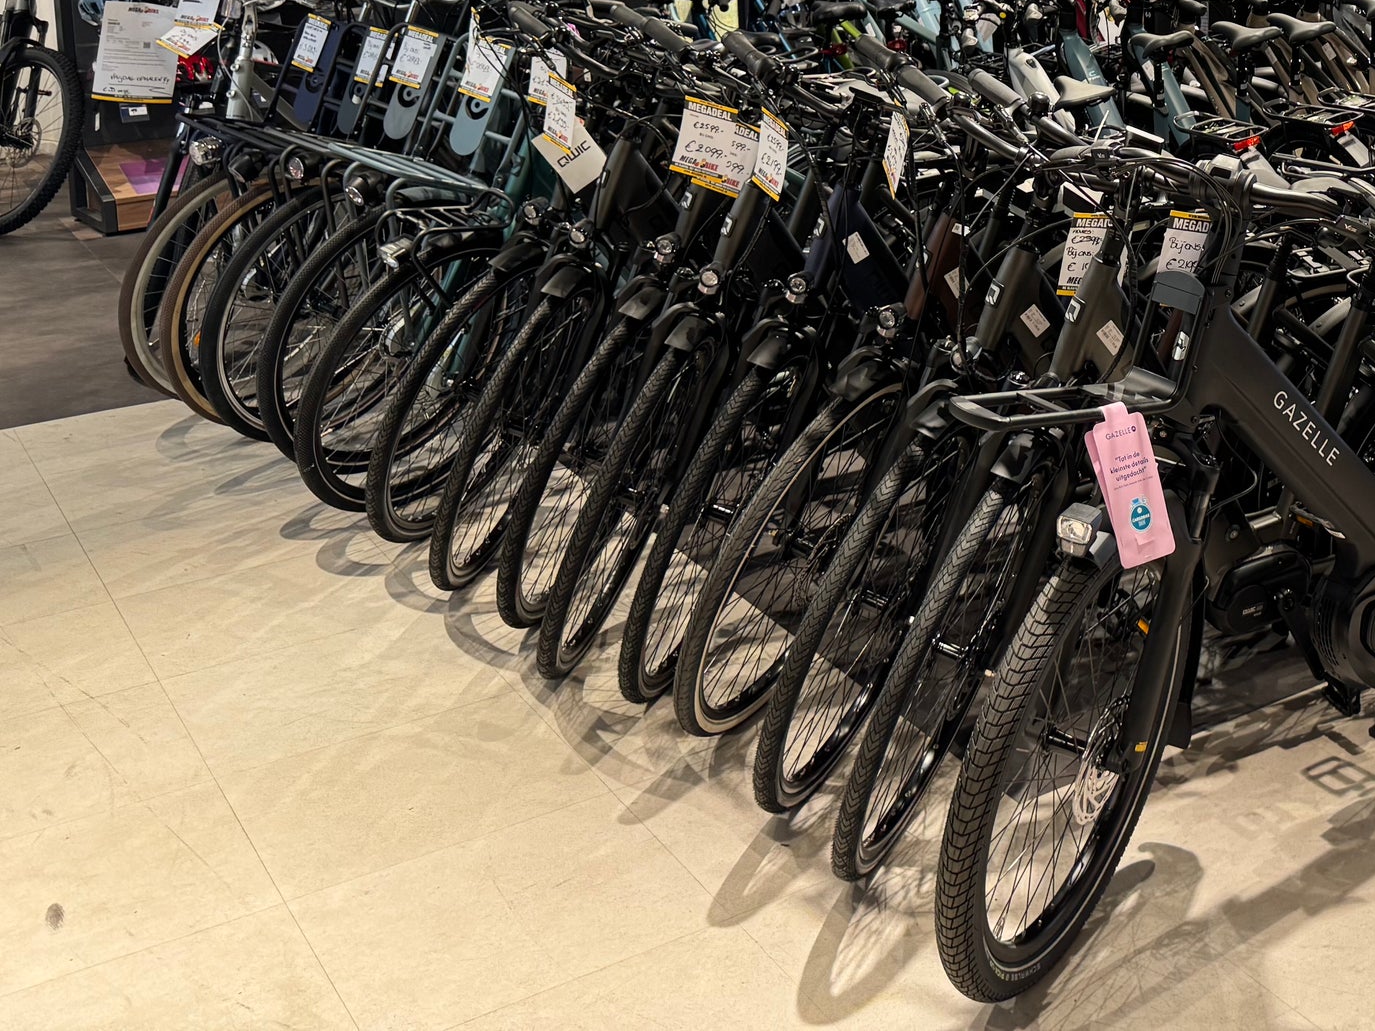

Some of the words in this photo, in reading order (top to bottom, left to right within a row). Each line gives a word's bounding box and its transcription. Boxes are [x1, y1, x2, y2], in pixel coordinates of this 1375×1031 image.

[688, 101, 733, 121] MEGADEAL
[556, 140, 591, 168] QWIC
[1105, 428, 1132, 441] GAZELLE
[1273, 390, 1340, 466] GAZELLE
[1110, 462, 1132, 475] kleinste
[1131, 457, 1149, 469] details
